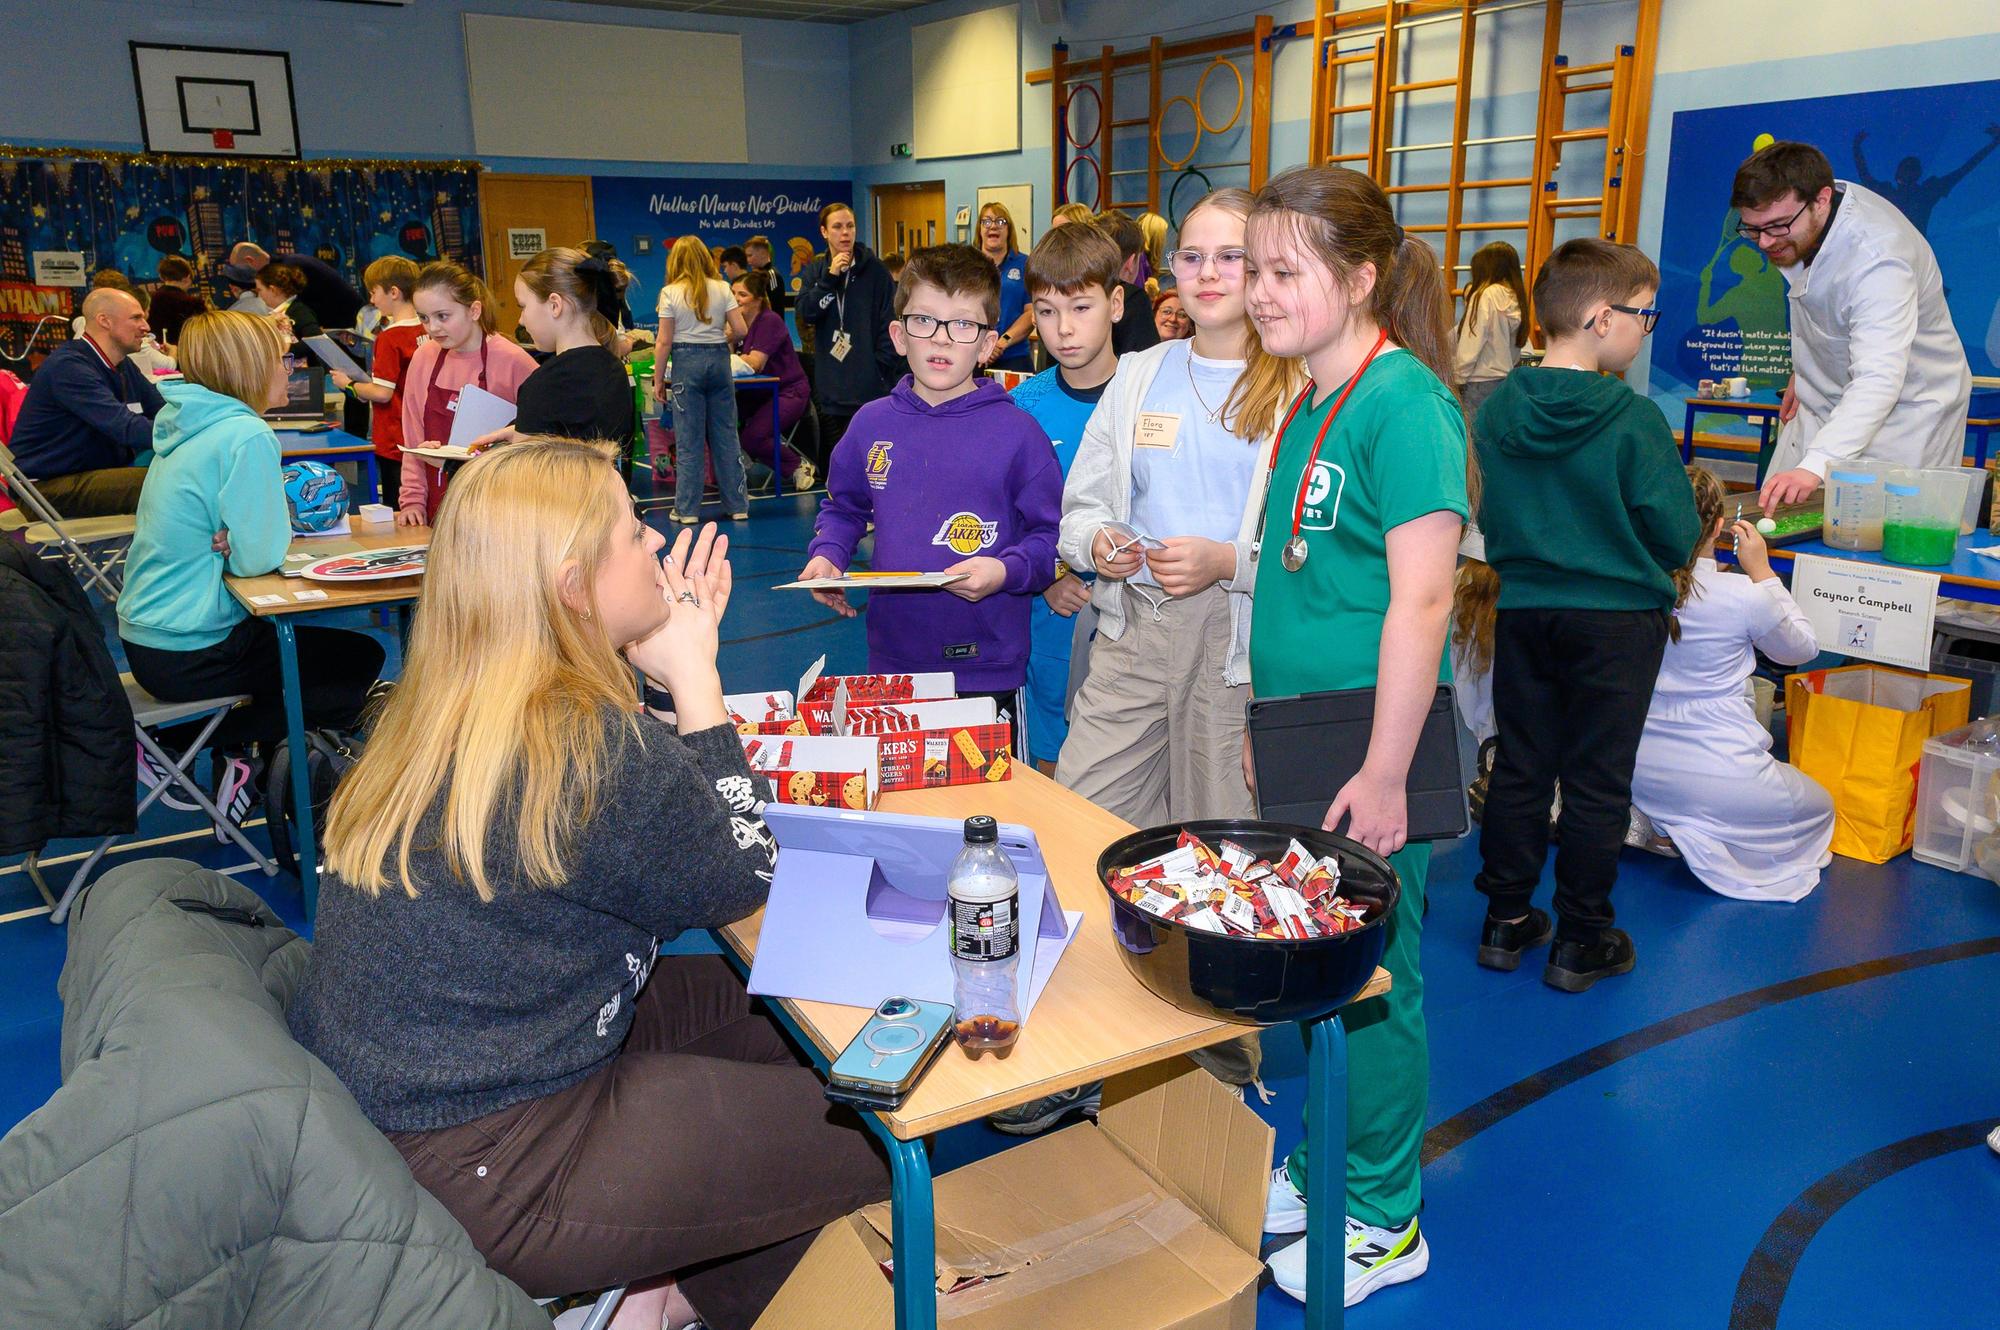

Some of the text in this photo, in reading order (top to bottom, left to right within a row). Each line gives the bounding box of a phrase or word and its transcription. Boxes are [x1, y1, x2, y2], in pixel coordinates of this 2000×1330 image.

[650, 194, 822, 216] Nullus Murus Nos Dividit
[699, 218, 776, 230] No Wall Divides Us
[1716, 329, 1744, 338] doesn't
[1745, 330, 1772, 339] matter
[1773, 331, 1791, 340] what
[1686, 340, 1726, 351] background
[1727, 341, 1734, 349] is
[1744, 342, 1767, 351] where
[1768, 344, 1780, 353] you
[1701, 353, 1708, 361] if
[1709, 353, 1721, 362] you
[1722, 353, 1739, 361] have
[1740, 353, 1768, 362] dreams
[1769, 354, 1783, 362] and
[1710, 362, 1731, 371] that's
[1732, 364, 1741, 372] all
[1741, 364, 1758, 373] that
[1143, 418, 1164, 429] Flora
[940, 523, 995, 546] LAKERS
[1813, 587, 1913, 614] Gaynor Campbell
[880, 739, 917, 756] KER'S
